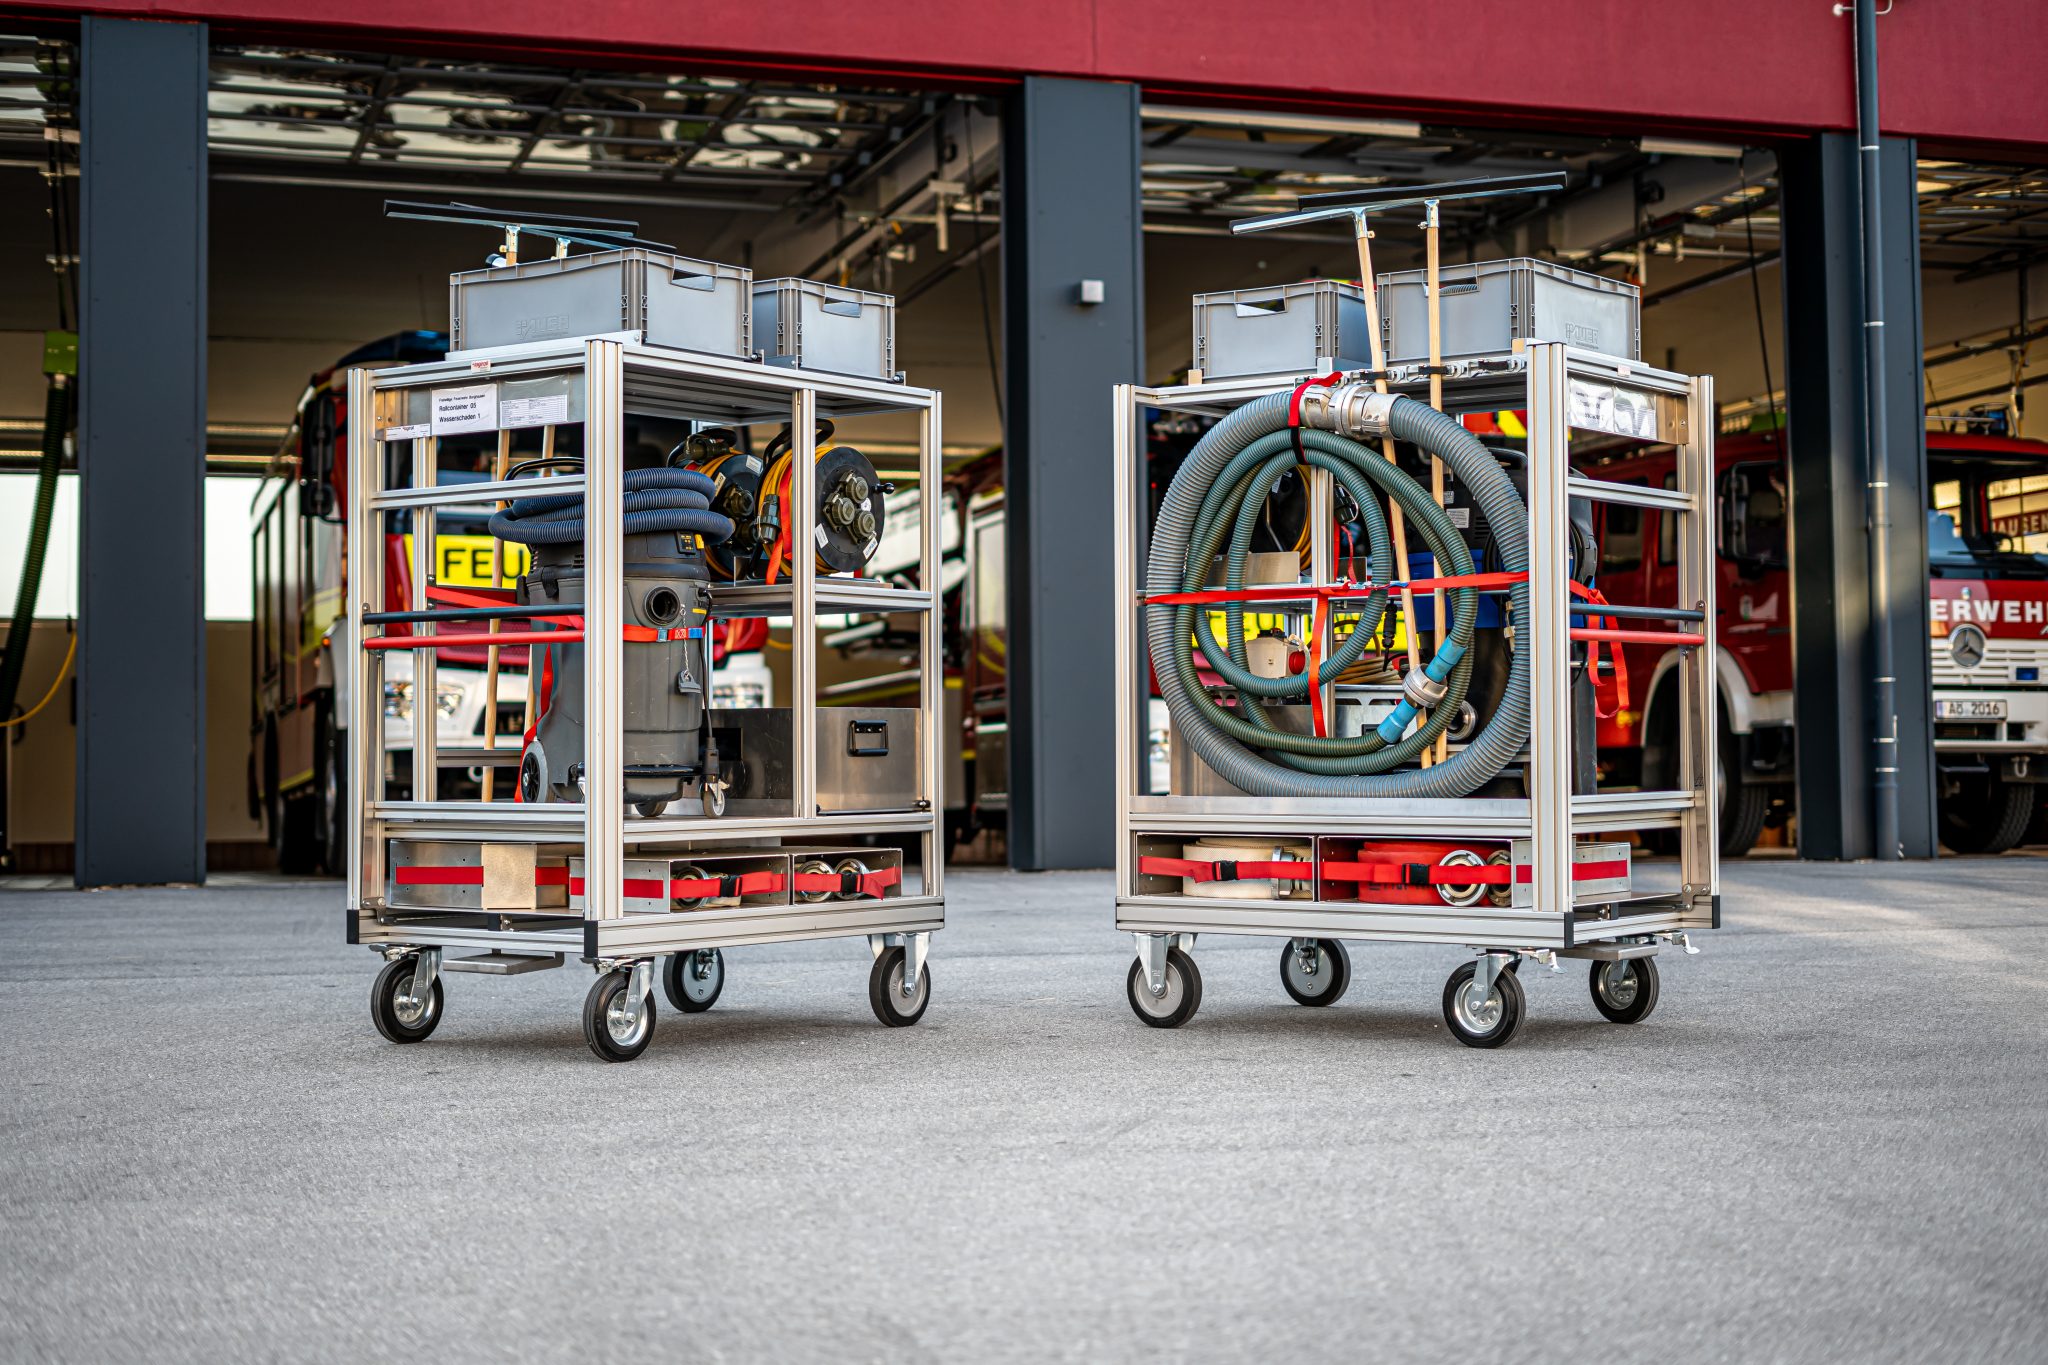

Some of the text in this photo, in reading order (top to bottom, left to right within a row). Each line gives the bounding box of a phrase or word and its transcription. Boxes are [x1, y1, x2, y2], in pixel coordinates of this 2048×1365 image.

[439, 403, 468, 412] Rollcontainer
[439, 414, 476, 423] Wasserschaden
[1930, 598, 2048, 623] ERWEH
[1971, 702, 2000, 716] 2016
